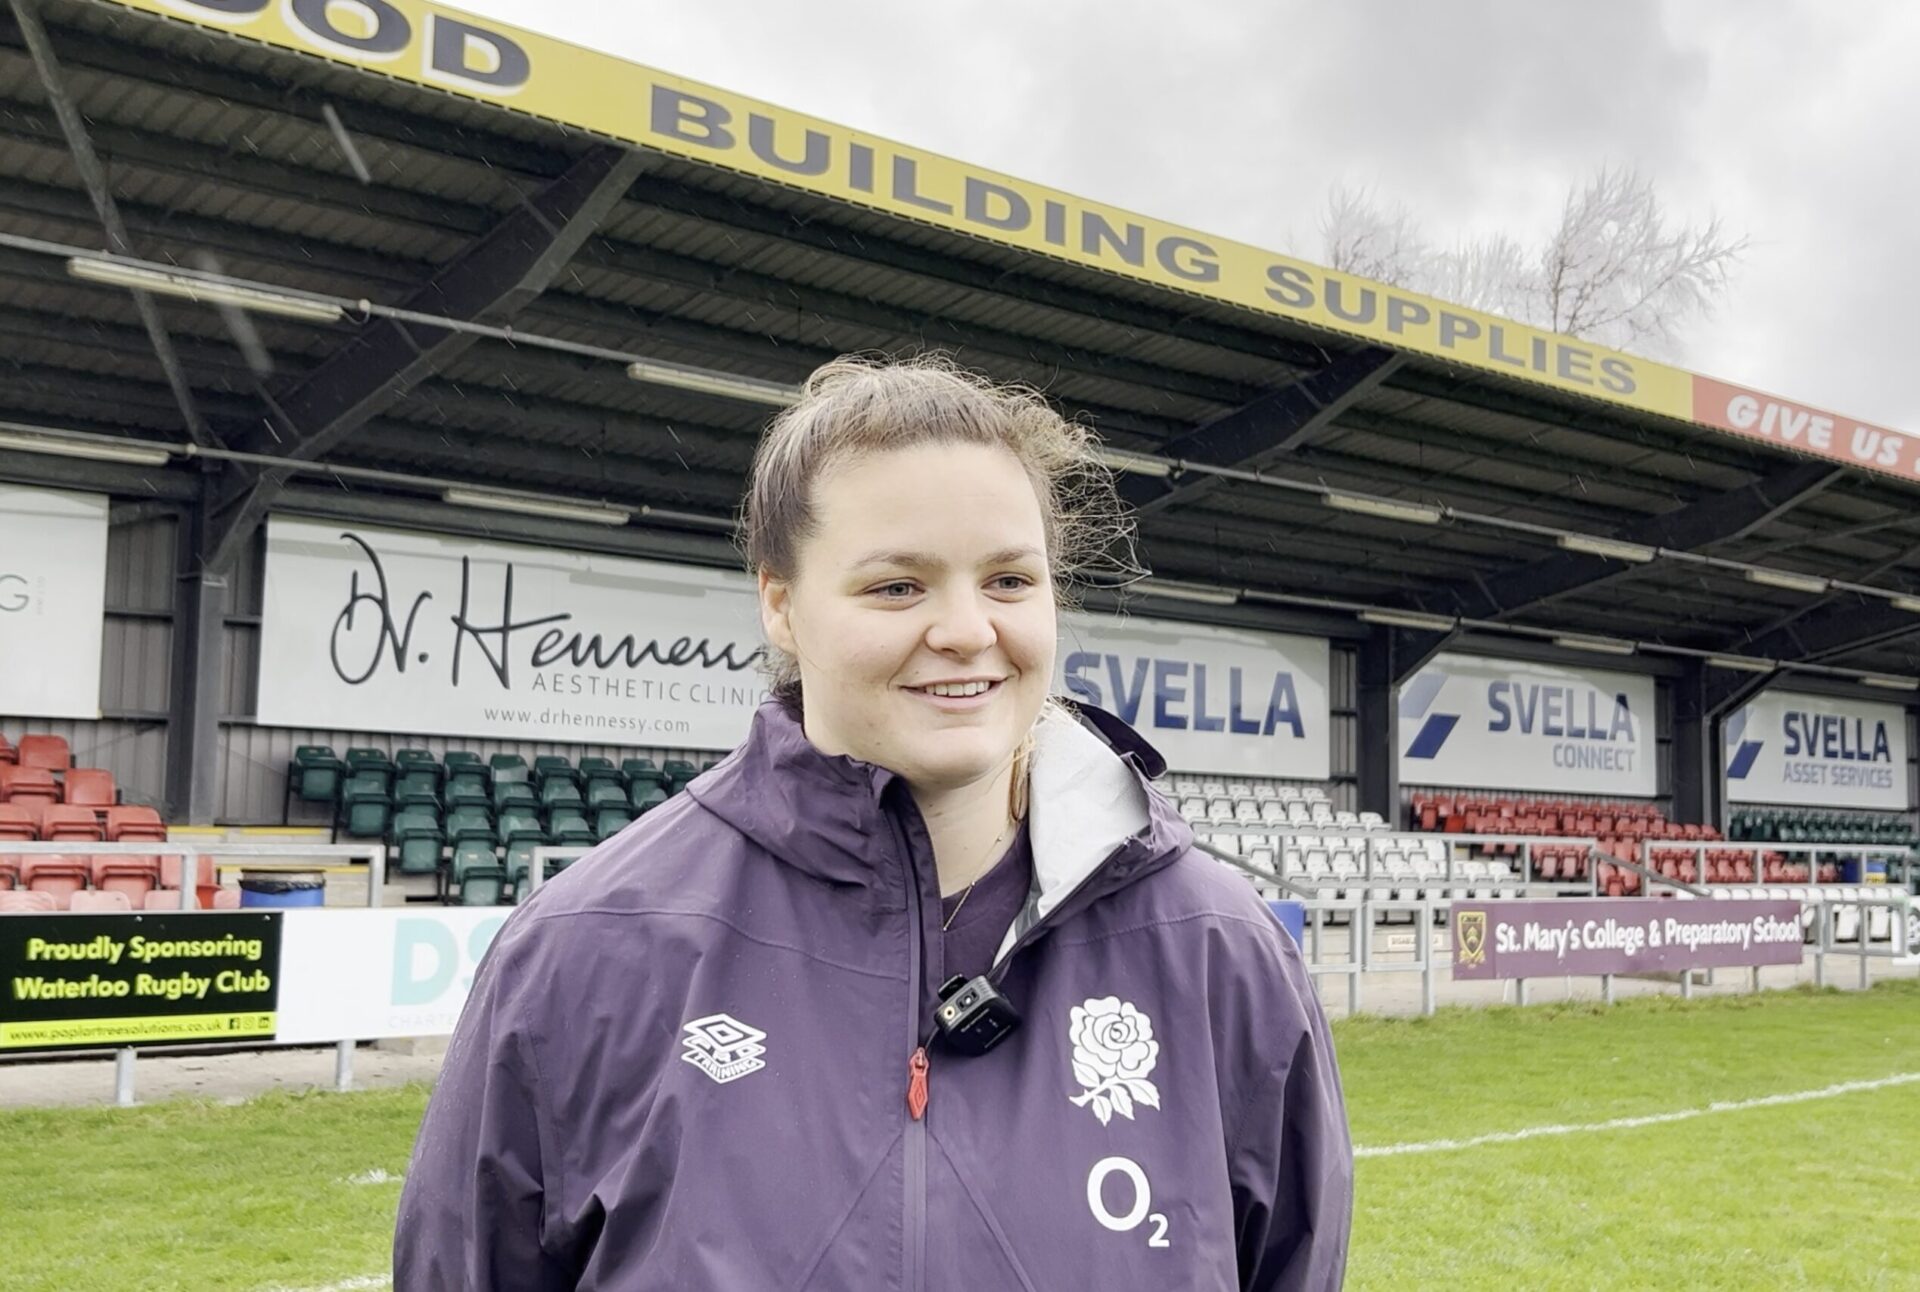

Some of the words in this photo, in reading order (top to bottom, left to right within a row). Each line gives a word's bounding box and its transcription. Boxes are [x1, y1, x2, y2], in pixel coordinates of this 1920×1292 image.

[152, 0, 531, 97] OD
[650, 83, 1221, 284] BUILDING
[1264, 264, 1637, 396] SUPPLIES
[1727, 394, 1833, 448] GIVE
[1851, 427, 1903, 467] US
[532, 672, 682, 703] AESTHETIC
[1064, 651, 1305, 739] SVELLA
[484, 707, 690, 734] www.drhennessy.com
[1487, 680, 1635, 742] SVELLA
[1784, 711, 1892, 763] SVELLA
[1552, 744, 1635, 772] CONNECT
[1783, 762, 1828, 784] ASSET
[1831, 766, 1892, 789] SERVICES
[27, 935, 125, 964] Proudly
[128, 933, 263, 963] Sponsoring
[1495, 922, 1521, 953] St.
[1523, 920, 1580, 959] Mary's
[1582, 919, 1645, 955] College
[1648, 920, 1662, 948] &
[1664, 917, 1751, 952] Preparatory
[1752, 915, 1801, 944] School
[13, 974, 130, 1000] Waterloo
[135, 971, 211, 1000] Rugby
[215, 968, 271, 993] Club
